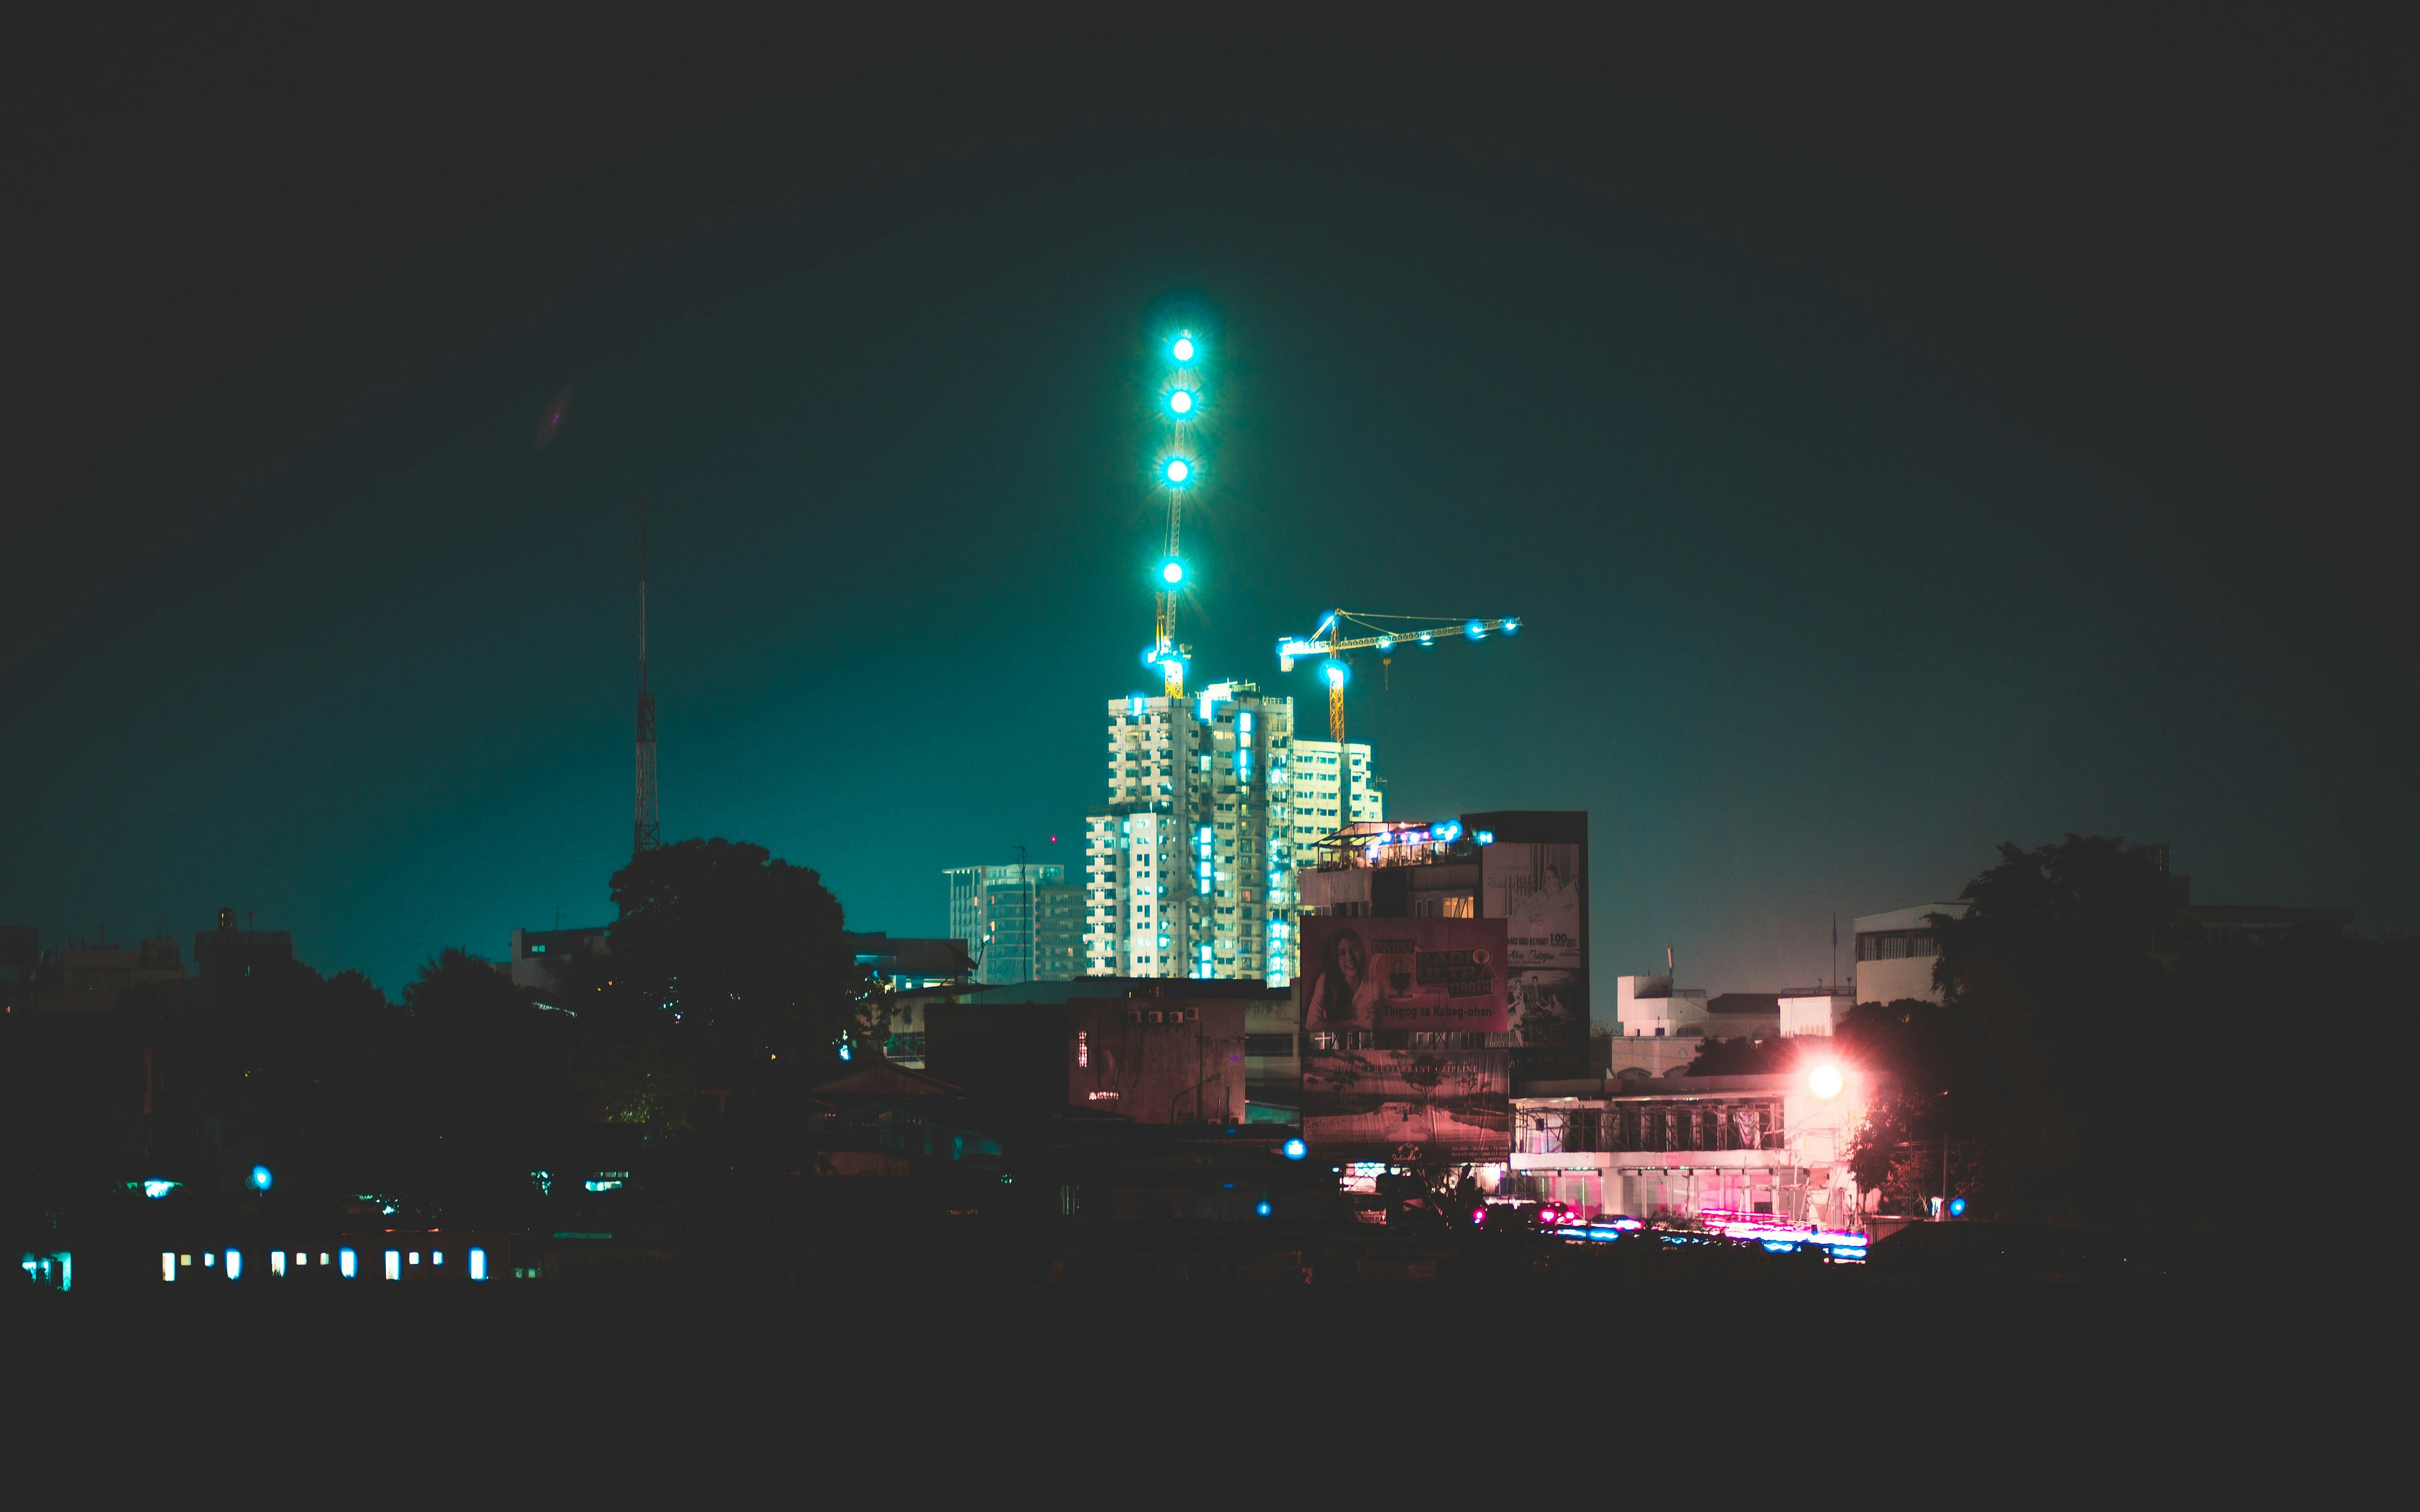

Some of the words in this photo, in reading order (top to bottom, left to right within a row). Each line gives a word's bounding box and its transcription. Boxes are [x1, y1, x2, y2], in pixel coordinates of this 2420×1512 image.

[1529, 937, 1549, 946] 8570007
[1549, 933, 1567, 943] 100
[1418, 965, 1496, 980] ULTRA
[1383, 1005, 1417, 1019] Tingog
[1420, 1008, 1430, 1017] sa
[1433, 1005, 1492, 1019] Kabag-ohan
[1374, 1064, 1431, 1073] RESTAURANT
[1441, 1064, 1478, 1074] ZIPLINE
